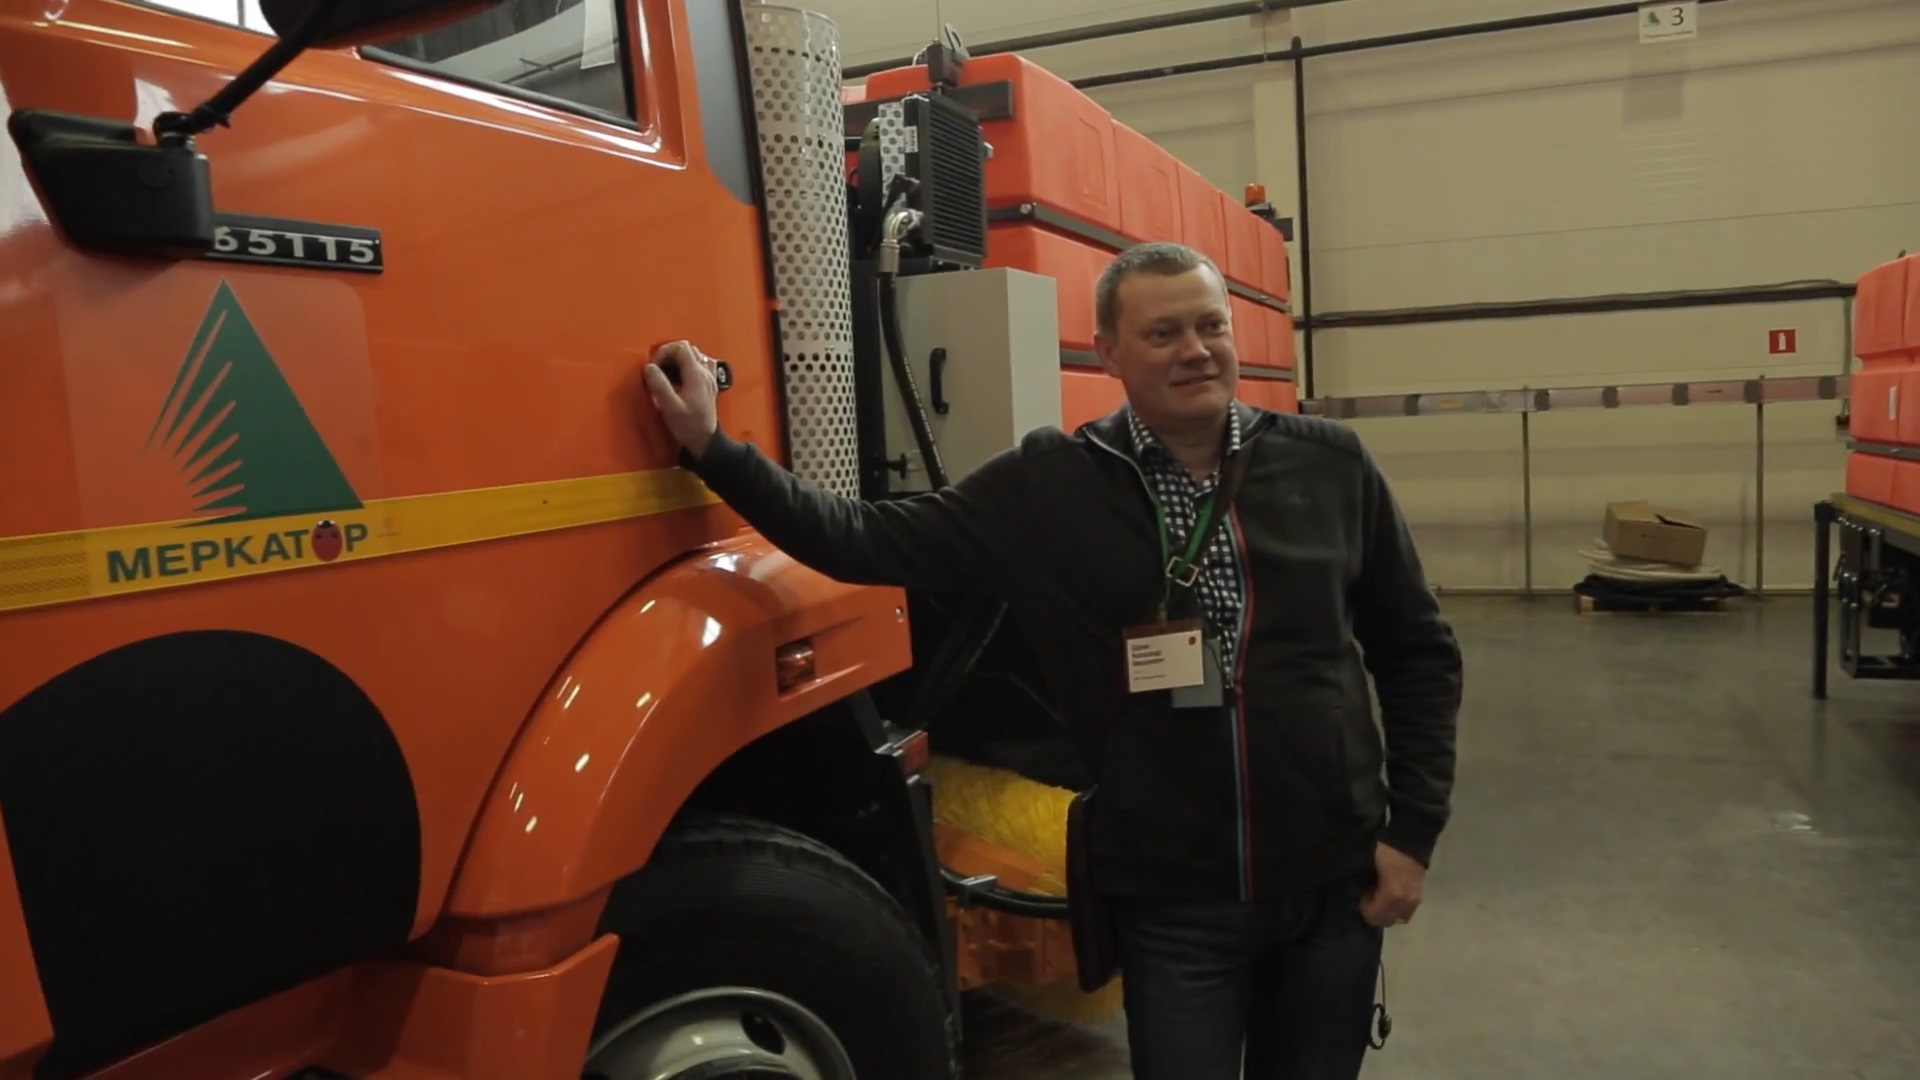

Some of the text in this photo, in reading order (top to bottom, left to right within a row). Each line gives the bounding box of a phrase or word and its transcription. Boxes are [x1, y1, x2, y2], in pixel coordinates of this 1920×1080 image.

[1671, 7, 1685, 27] 3
[214, 226, 376, 264] 65115
[106, 520, 370, 584] МЕРКАТР
